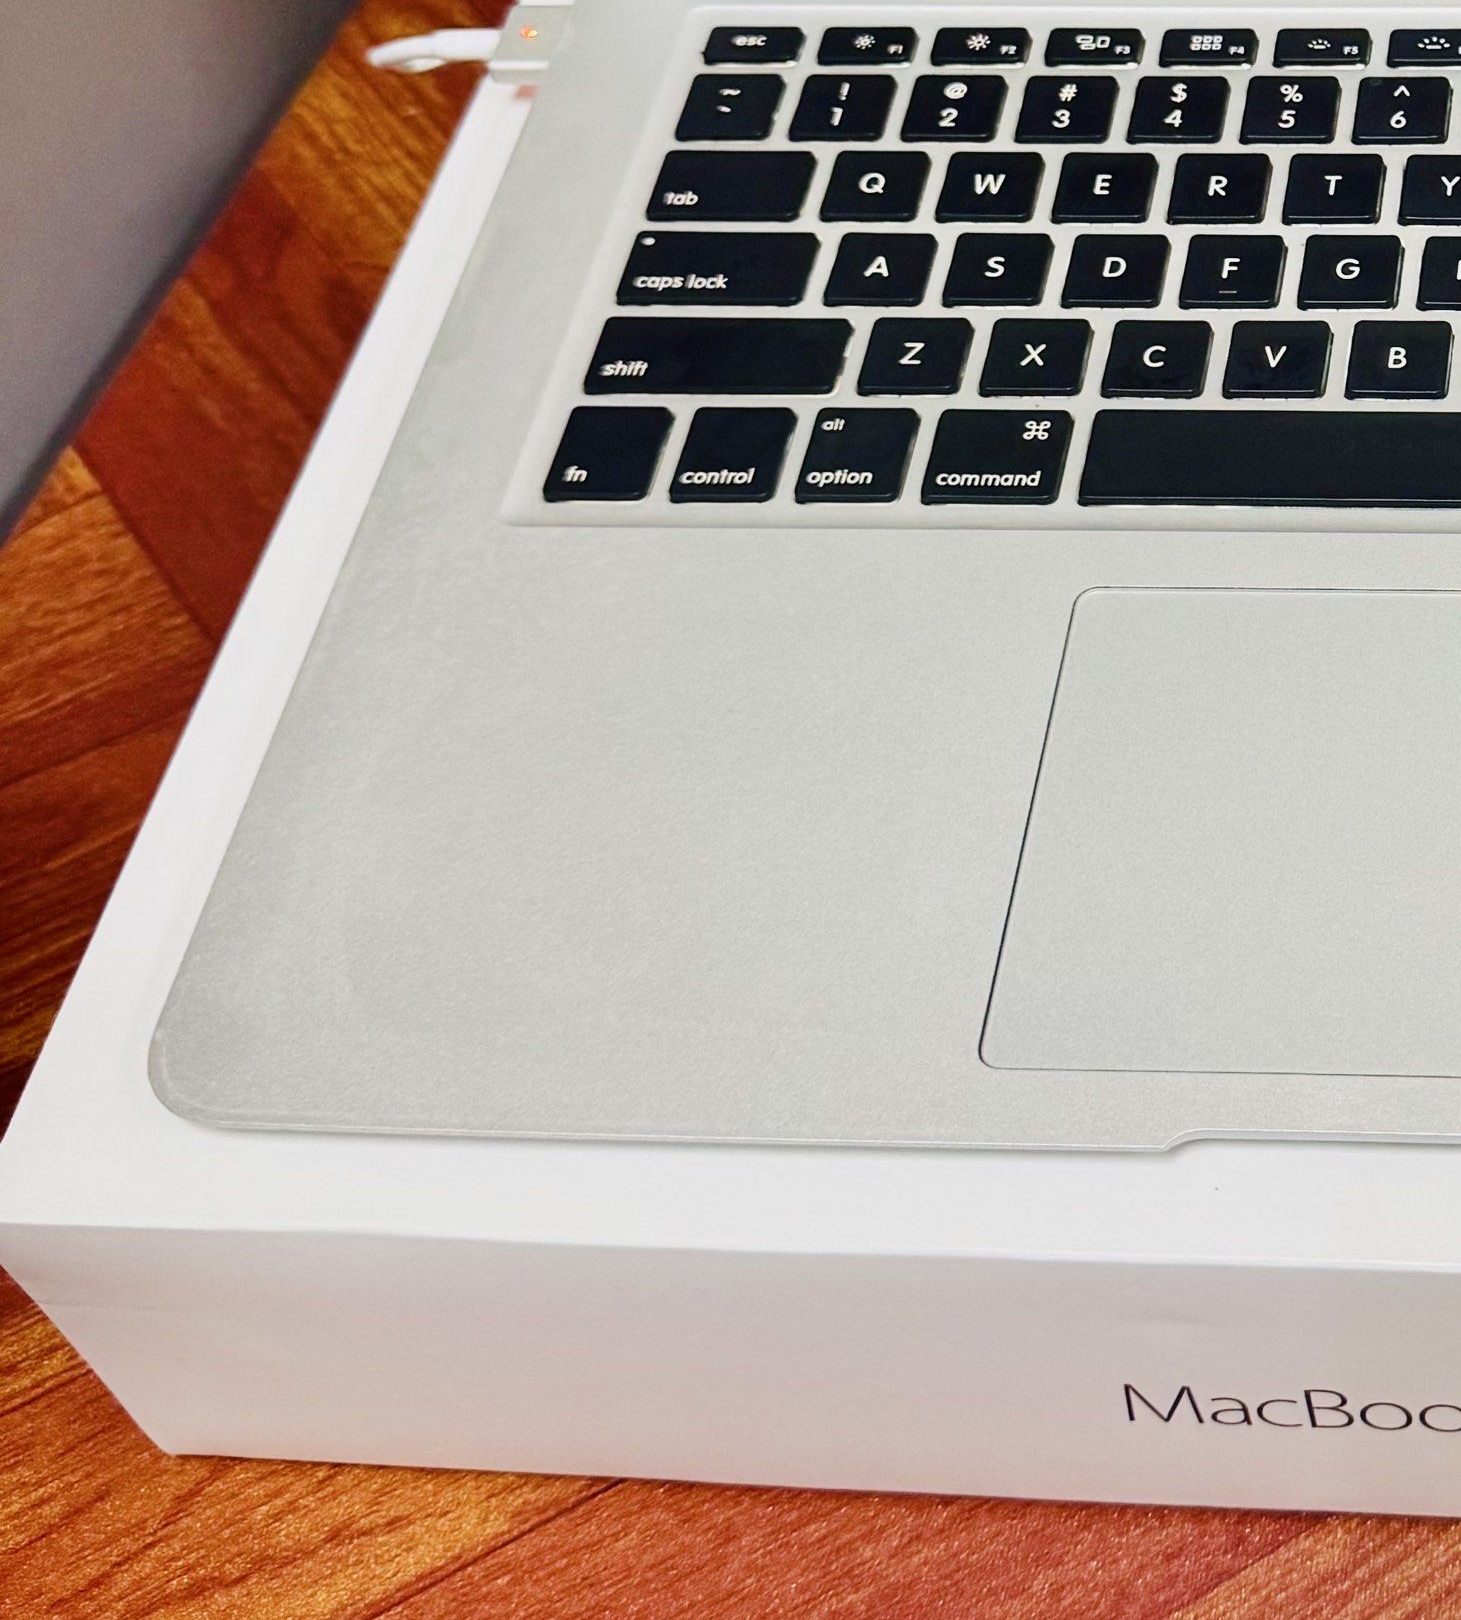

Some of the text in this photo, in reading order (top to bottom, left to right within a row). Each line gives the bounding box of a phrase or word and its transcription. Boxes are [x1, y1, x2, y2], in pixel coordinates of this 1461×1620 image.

[733, 36, 767, 46] esc
[889, 45, 903, 55] F1
[1000, 46, 1016, 54] F2
[1115, 46, 1130, 54] F3
[1229, 46, 1244, 54] F4
[1344, 46, 1358, 54] F5
[831, 107, 843, 125] 1
[939, 108, 958, 126] 2
[1053, 109, 1070, 128] 3
[1164, 110, 1182, 127] 4
[1278, 110, 1296, 128] 5
[1390, 111, 1406, 128] 6
[859, 173, 885, 193] Q
[975, 174, 1005, 194] W
[1094, 175, 1112, 194] E
[1208, 176, 1227, 196] R
[1325, 176, 1342, 195] T
[1441, 176, 1460, 196] Y
[665, 191, 698, 205] tab
[864, 256, 888, 277] A
[985, 257, 1005, 277] S
[1103, 257, 1126, 277] D
[1222, 258, 1240, 278] F
[1336, 259, 1360, 279] G
[634, 274, 728, 291] caps lock
[899, 343, 924, 364] Z
[1020, 344, 1046, 366] X
[1143, 346, 1166, 367] C
[1265, 346, 1286, 367] V
[1388, 347, 1406, 368] B
[602, 361, 648, 376] shift
[822, 419, 845, 430] alt
[565, 466, 587, 481] fn
[680, 468, 755, 484] control
[807, 469, 872, 487] option
[936, 471, 1041, 486] command
